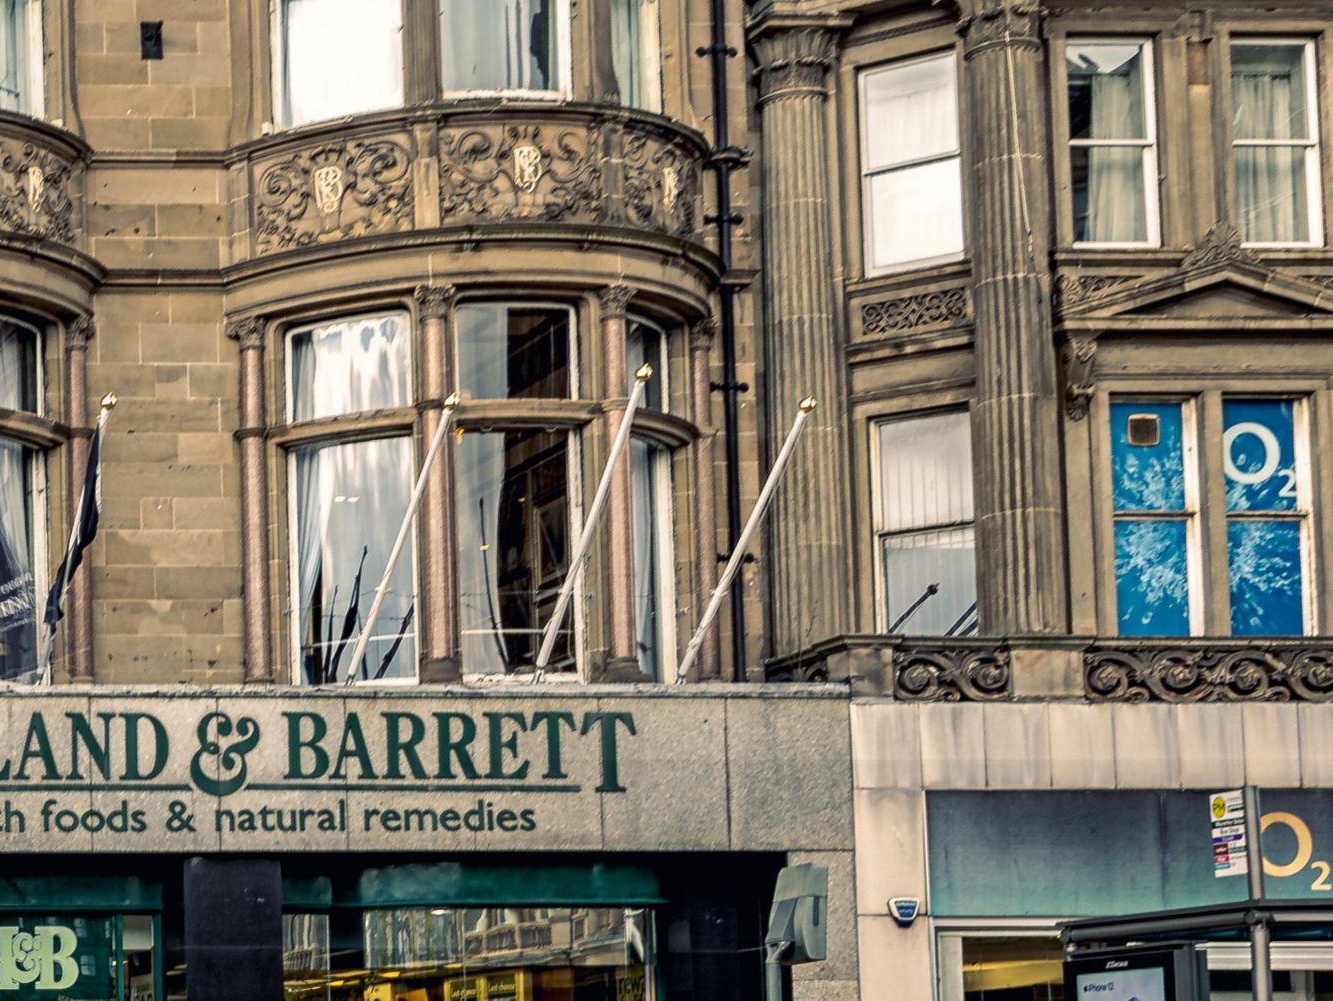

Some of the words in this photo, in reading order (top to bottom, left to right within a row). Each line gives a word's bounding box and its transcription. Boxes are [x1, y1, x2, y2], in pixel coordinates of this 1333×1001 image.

[190, 711, 260, 796] &
[282, 711, 637, 793] BARRETT
[41, 801, 147, 833] foods
[165, 801, 196, 832] &
[214, 801, 347, 832] natural
[364, 801, 537, 832] remedies
